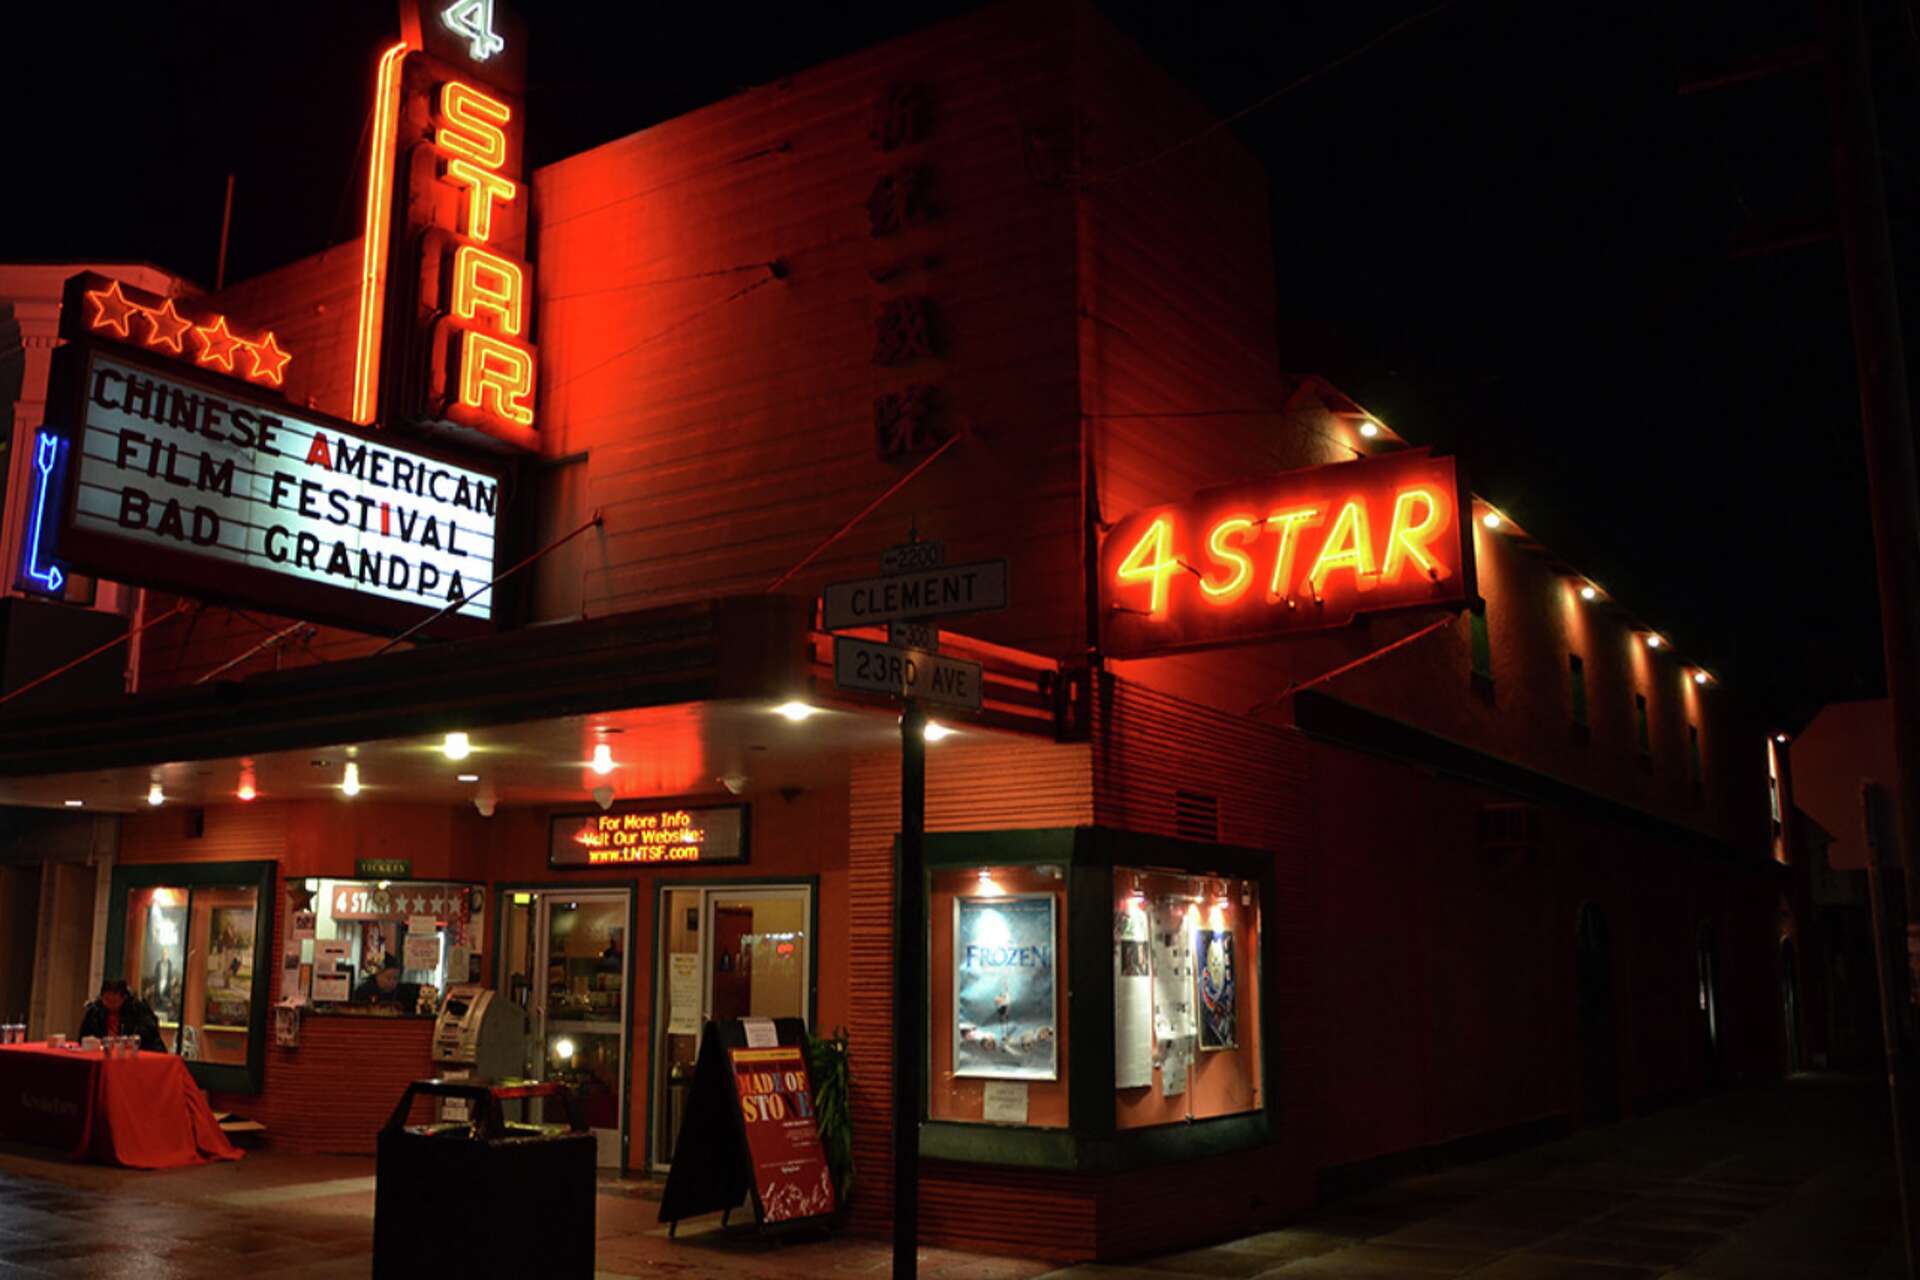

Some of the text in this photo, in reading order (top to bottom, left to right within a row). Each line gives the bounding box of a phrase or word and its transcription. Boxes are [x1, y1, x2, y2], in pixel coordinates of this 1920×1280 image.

[438, 0, 533, 425] 4 STAR
[93, 367, 499, 517] CHINESE AMERICAN
[116, 427, 469, 557] FILM FESTIVAL
[118, 486, 467, 604] BAD GRANDPA
[1116, 484, 1452, 621] 4 STAR
[852, 573, 977, 616] CLEMENT
[856, 650, 968, 697] 23RD AVE
[599, 809, 691, 831] For More Info
[613, 831, 638, 845] Our
[335, 891, 347, 913] 4
[966, 944, 1050, 969] FROZEN
